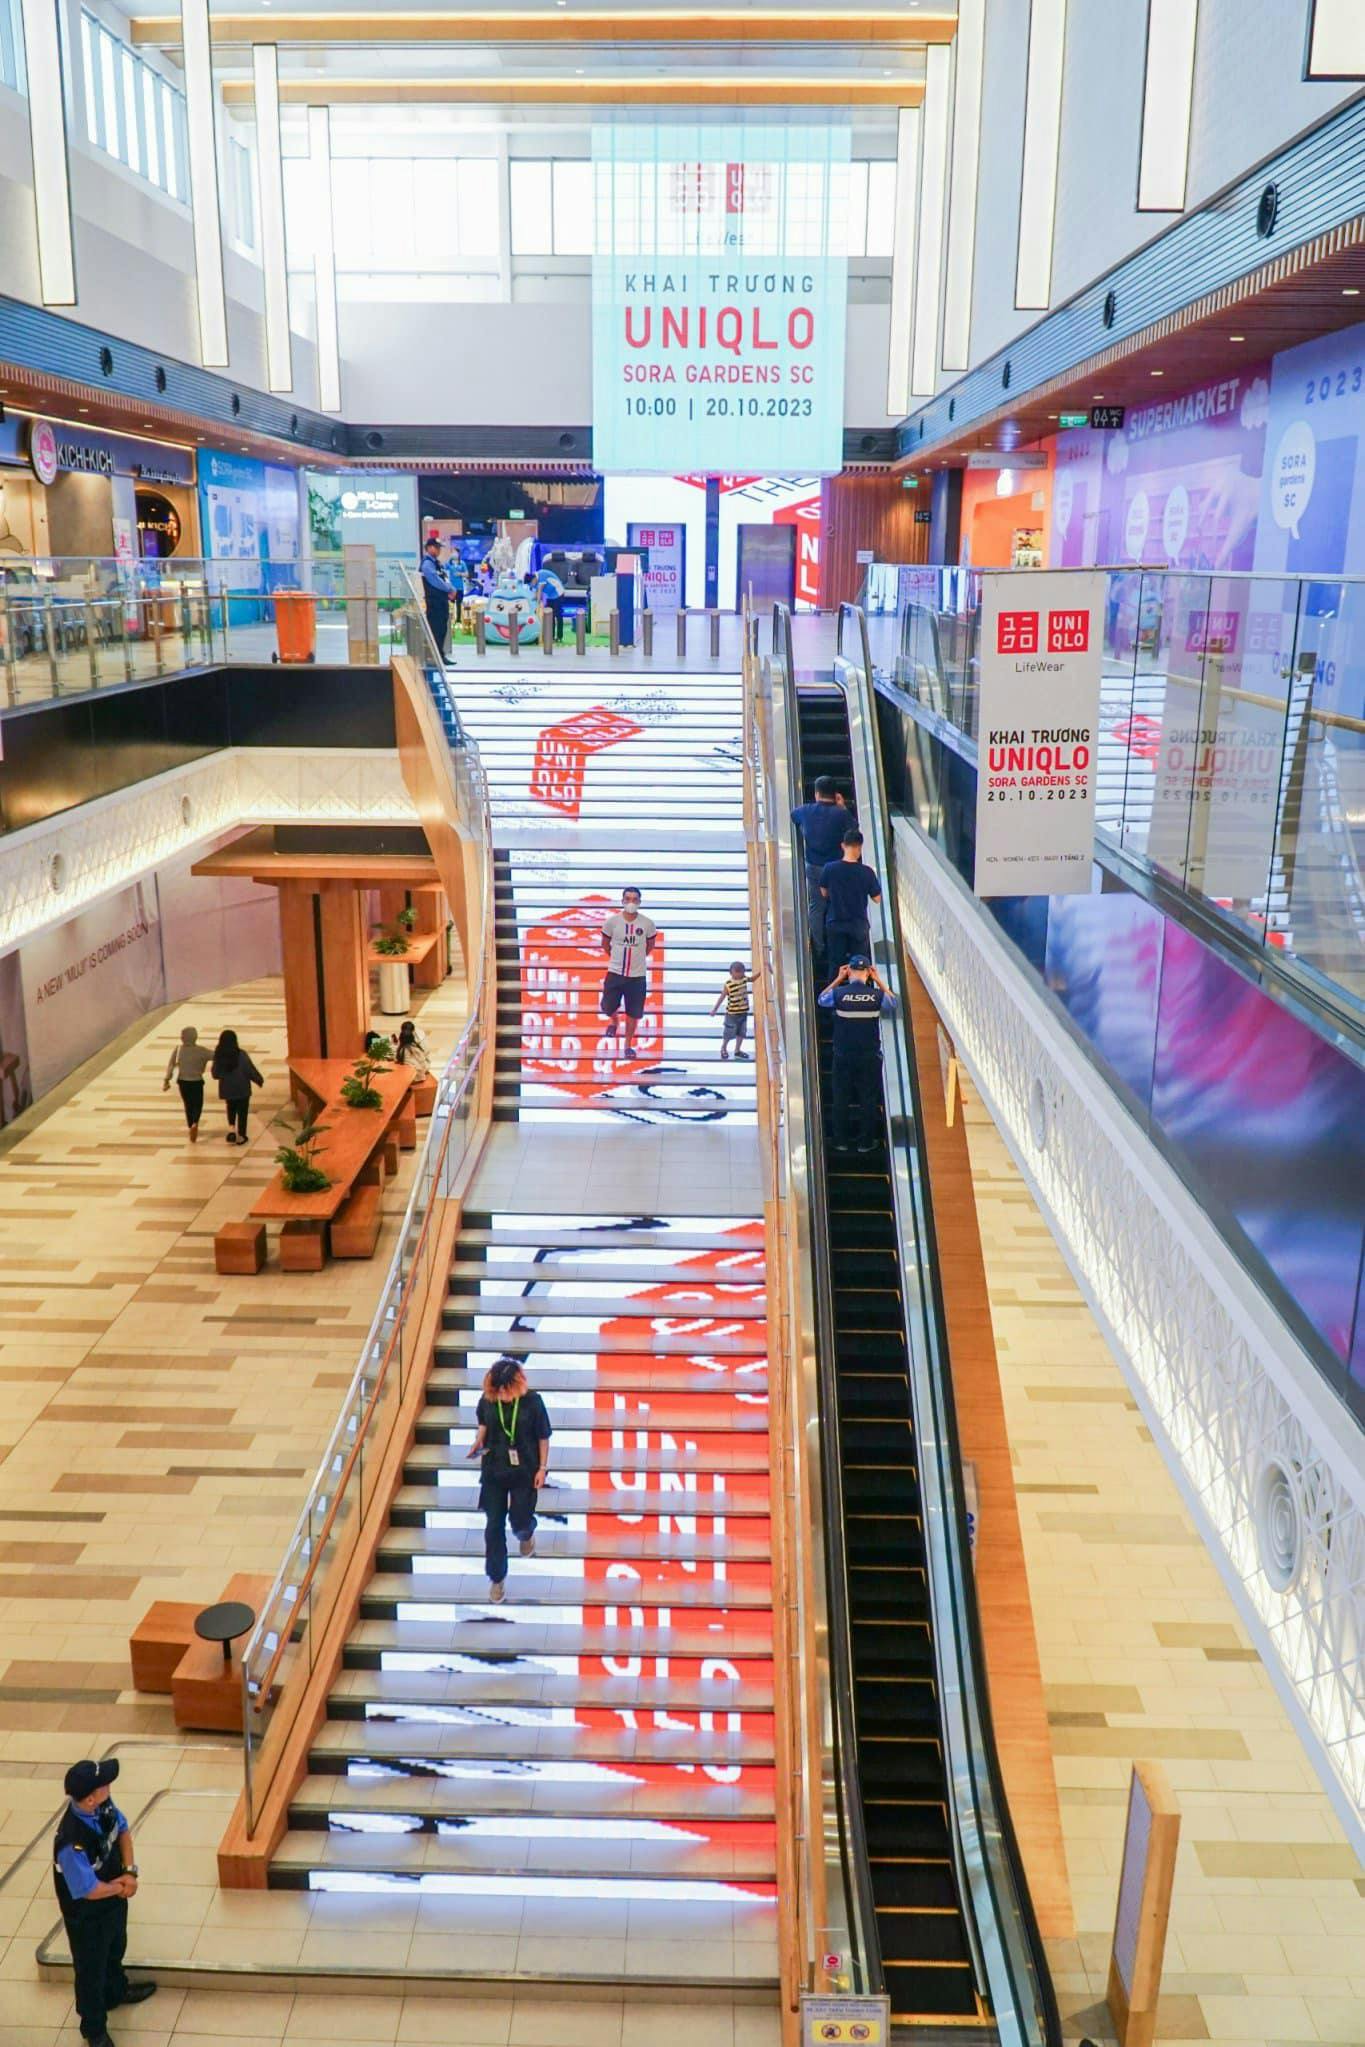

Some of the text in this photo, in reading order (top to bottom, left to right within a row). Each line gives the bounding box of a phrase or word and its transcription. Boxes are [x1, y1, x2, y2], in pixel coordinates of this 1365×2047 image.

[625, 273, 814, 293] KHAI TRƯƠNG
[625, 306, 814, 356] UNIQLO
[624, 364, 814, 384] SORA GARDENS SC
[1305, 366, 1362, 404] 2023
[626, 397, 676, 416] 10:00
[706, 397, 812, 417] 20.10.2023
[1128, 378, 1240, 440] SUPERMARKET
[56, 442, 115, 473] KICHI-KICHI
[1281, 458, 1307, 470] SORA
[1284, 493, 1297, 508] SC
[645, 572, 676, 582] NIQLO
[1052, 615, 1082, 631] UNI
[1052, 632, 1084, 650] QLO
[1015, 661, 1065, 673] LifeWear
[989, 728, 1090, 744] KHAI TRƯƠNG
[988, 745, 1090, 775] UNIQLO
[988, 775, 1088, 788] SORA GARDENS SC
[987, 788, 1088, 802] 20.10.2023
[37, 987, 44, 1004] A
[44, 973, 64, 997] NEW
[88, 952, 97, 969] IS
[97, 932, 126, 964] COMING
[126, 922, 149, 945] SOON
[842, 994, 876, 1002] ALSOK
